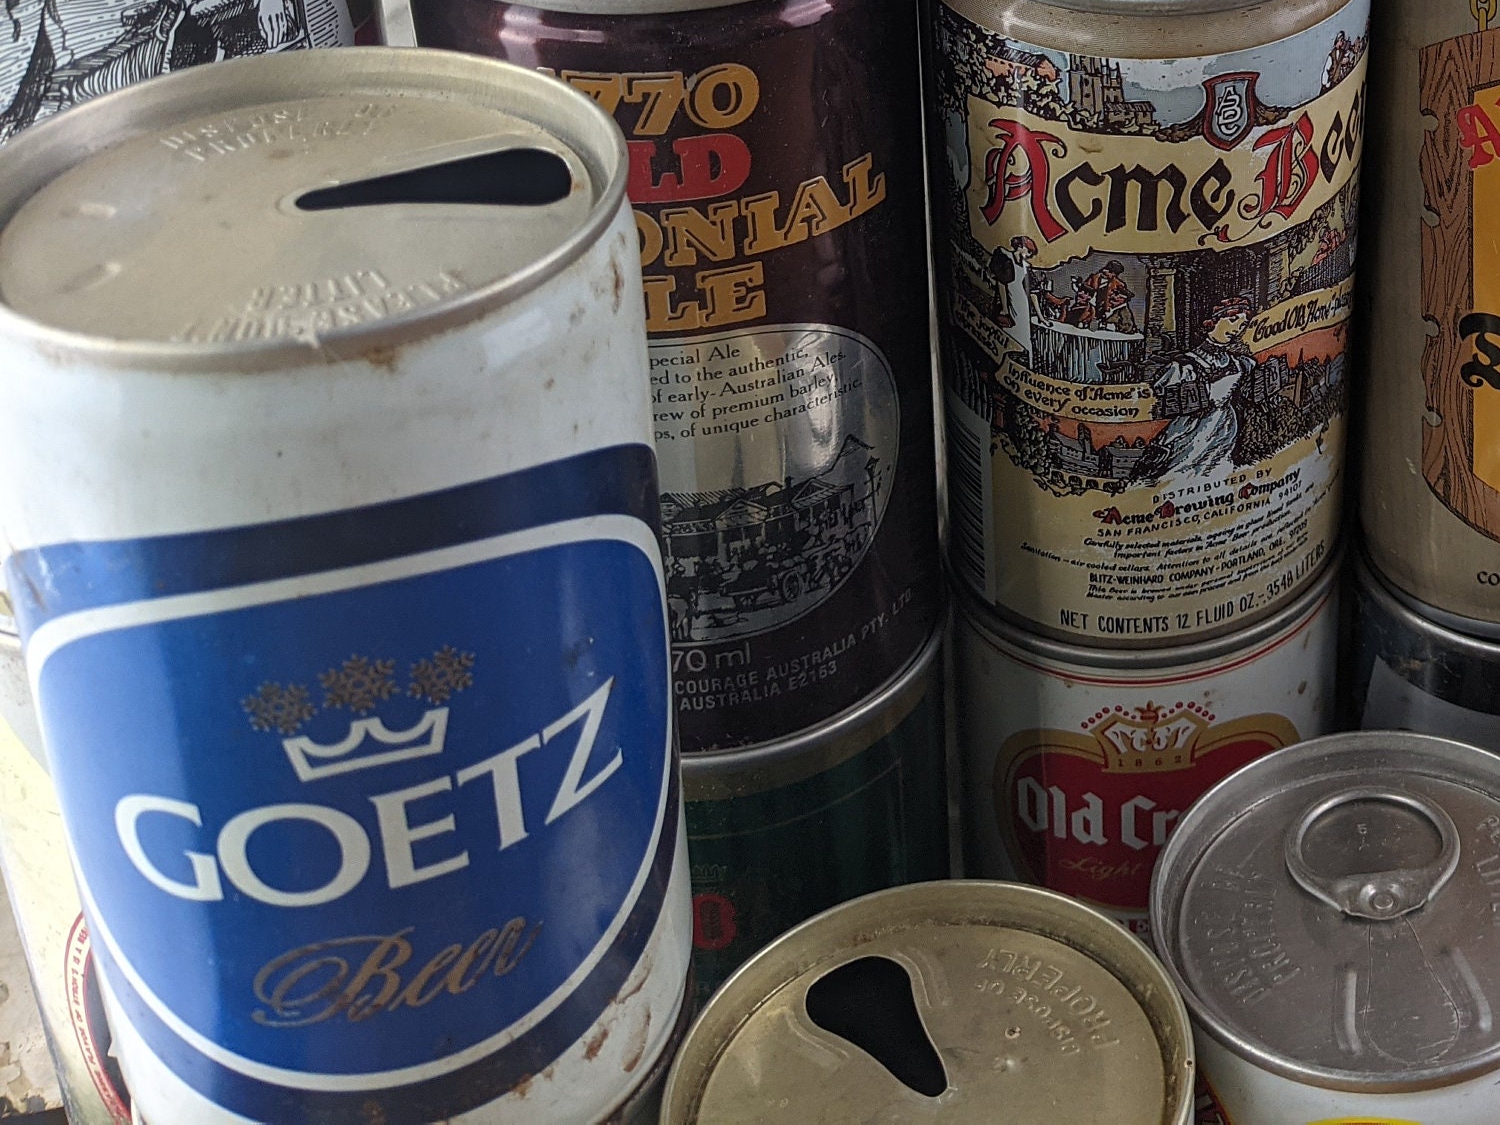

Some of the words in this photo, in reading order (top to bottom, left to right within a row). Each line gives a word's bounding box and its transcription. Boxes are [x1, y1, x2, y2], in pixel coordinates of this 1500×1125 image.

[537, 63, 760, 136] 770
[626, 132, 753, 205] LD
[979, 117, 1235, 244] Acme
[633, 151, 887, 268] ONIAL
[643, 261, 767, 333] LE
[708, 344, 742, 363] Ale
[701, 417, 760, 442] unique
[712, 391, 785, 420] premium
[1023, 385, 1068, 415] every
[1071, 405, 1140, 419] occasion
[1092, 506, 1154, 526] Acme
[1154, 493, 1235, 521] Brewing
[1238, 467, 1301, 500] Company
[1152, 475, 1247, 504] DISTRIBUTED
[1256, 468, 1273, 480] BY
[1097, 527, 1122, 537] SAN
[1203, 499, 1272, 520] CALIFORNIA
[1059, 609, 1089, 631] NET
[1097, 616, 1169, 634] CONTENTS
[1176, 613, 1191, 630] 12
[1196, 598, 1234, 627] FLUID
[675, 670, 759, 695] COURAGE
[766, 634, 857, 679] AUSTRALIA
[715, 641, 752, 668] ml
[679, 683, 782, 711] AUSTRALIA
[112, 675, 625, 908] GOETZ
[1016, 775, 1110, 848] Old
[250, 914, 546, 1029] Beer
